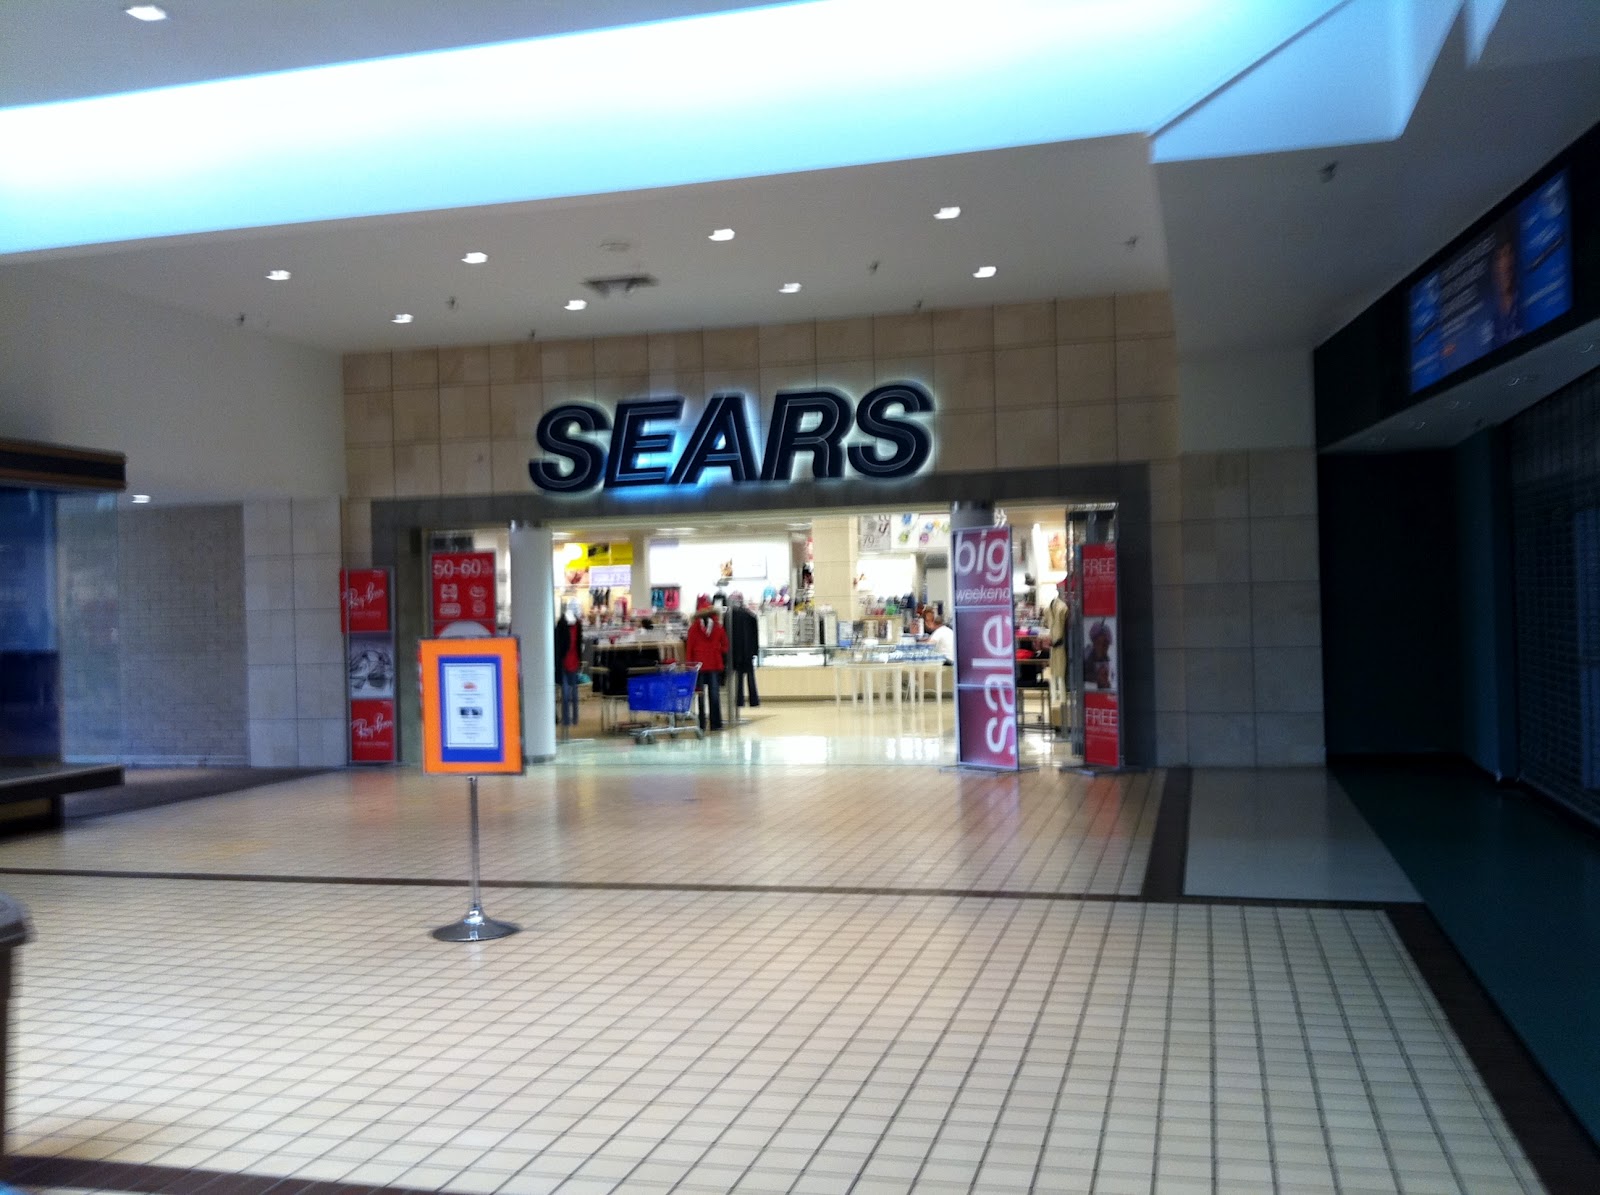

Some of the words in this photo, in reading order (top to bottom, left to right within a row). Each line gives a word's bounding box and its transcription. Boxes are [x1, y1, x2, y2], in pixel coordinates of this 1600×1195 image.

[528, 382, 936, 494] SEARS
[955, 530, 1009, 584] big
[1083, 557, 1116, 575] FREE
[956, 585, 1010, 600] weekend
[971, 613, 1016, 754] sale
[1085, 707, 1118, 727] FREE
